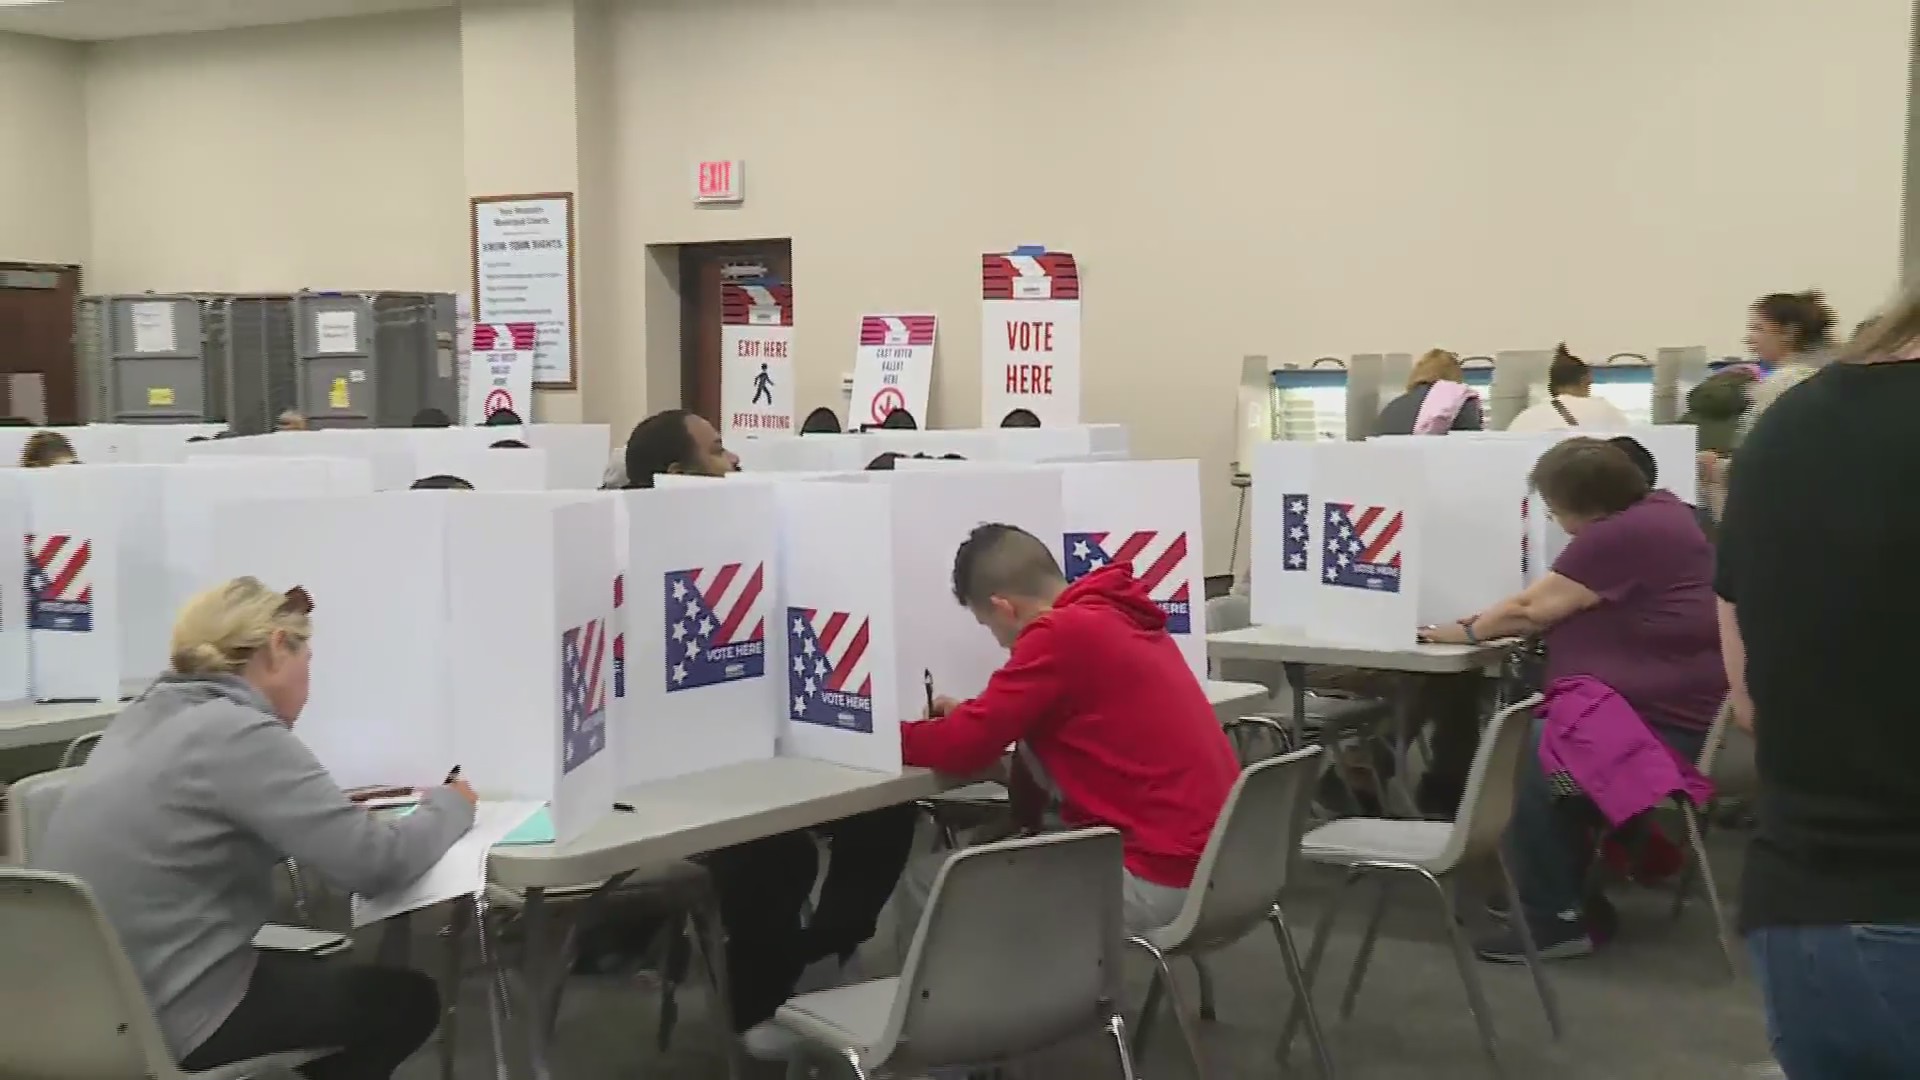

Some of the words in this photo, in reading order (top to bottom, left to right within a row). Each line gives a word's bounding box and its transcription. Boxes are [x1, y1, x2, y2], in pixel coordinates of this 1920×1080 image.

[699, 161, 731, 193] EXIT
[1006, 320, 1054, 352] VOTE
[738, 339, 760, 357] EXIT
[764, 341, 788, 358] HERE
[876, 349, 892, 359] CAST
[1006, 364, 1054, 394] HERE
[732, 412, 759, 428] AFTER
[761, 415, 790, 429] VOTING
[706, 647, 734, 662] VOTE
[736, 641, 763, 656] HERE
[821, 691, 845, 704] VOTE
[846, 695, 870, 710] HERE
